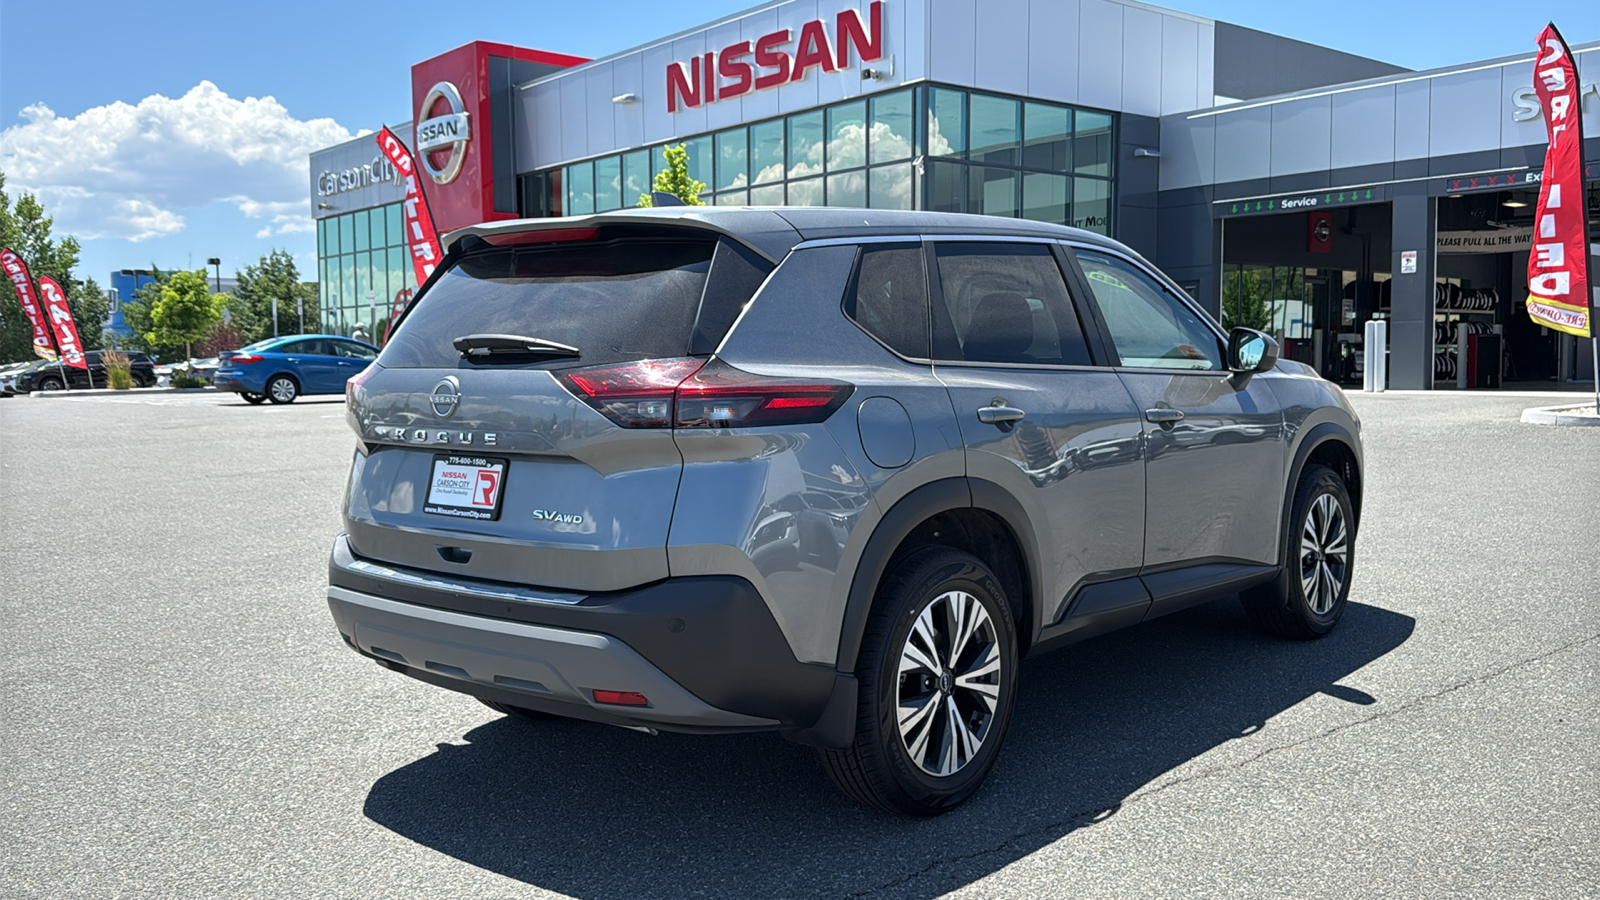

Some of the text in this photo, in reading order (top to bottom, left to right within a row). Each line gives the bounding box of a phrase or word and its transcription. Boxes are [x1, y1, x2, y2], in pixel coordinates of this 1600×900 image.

[667, 1, 883, 113] NISSAN
[418, 120, 458, 144] ISSAN
[317, 155, 401, 197] Carson City
[1281, 197, 1317, 209] Service
[1437, 234, 1532, 246] PLEASE PULL ALL THE WAY
[429, 395, 458, 404] NSSAN
[394, 428, 498, 446] ROGUE
[449, 456, 486, 466] 775-600-1500
[442, 471, 467, 479] NISSAN
[437, 479, 470, 488] CARSON CITY
[424, 506, 491, 519] www.NissanCarsonCity.com
